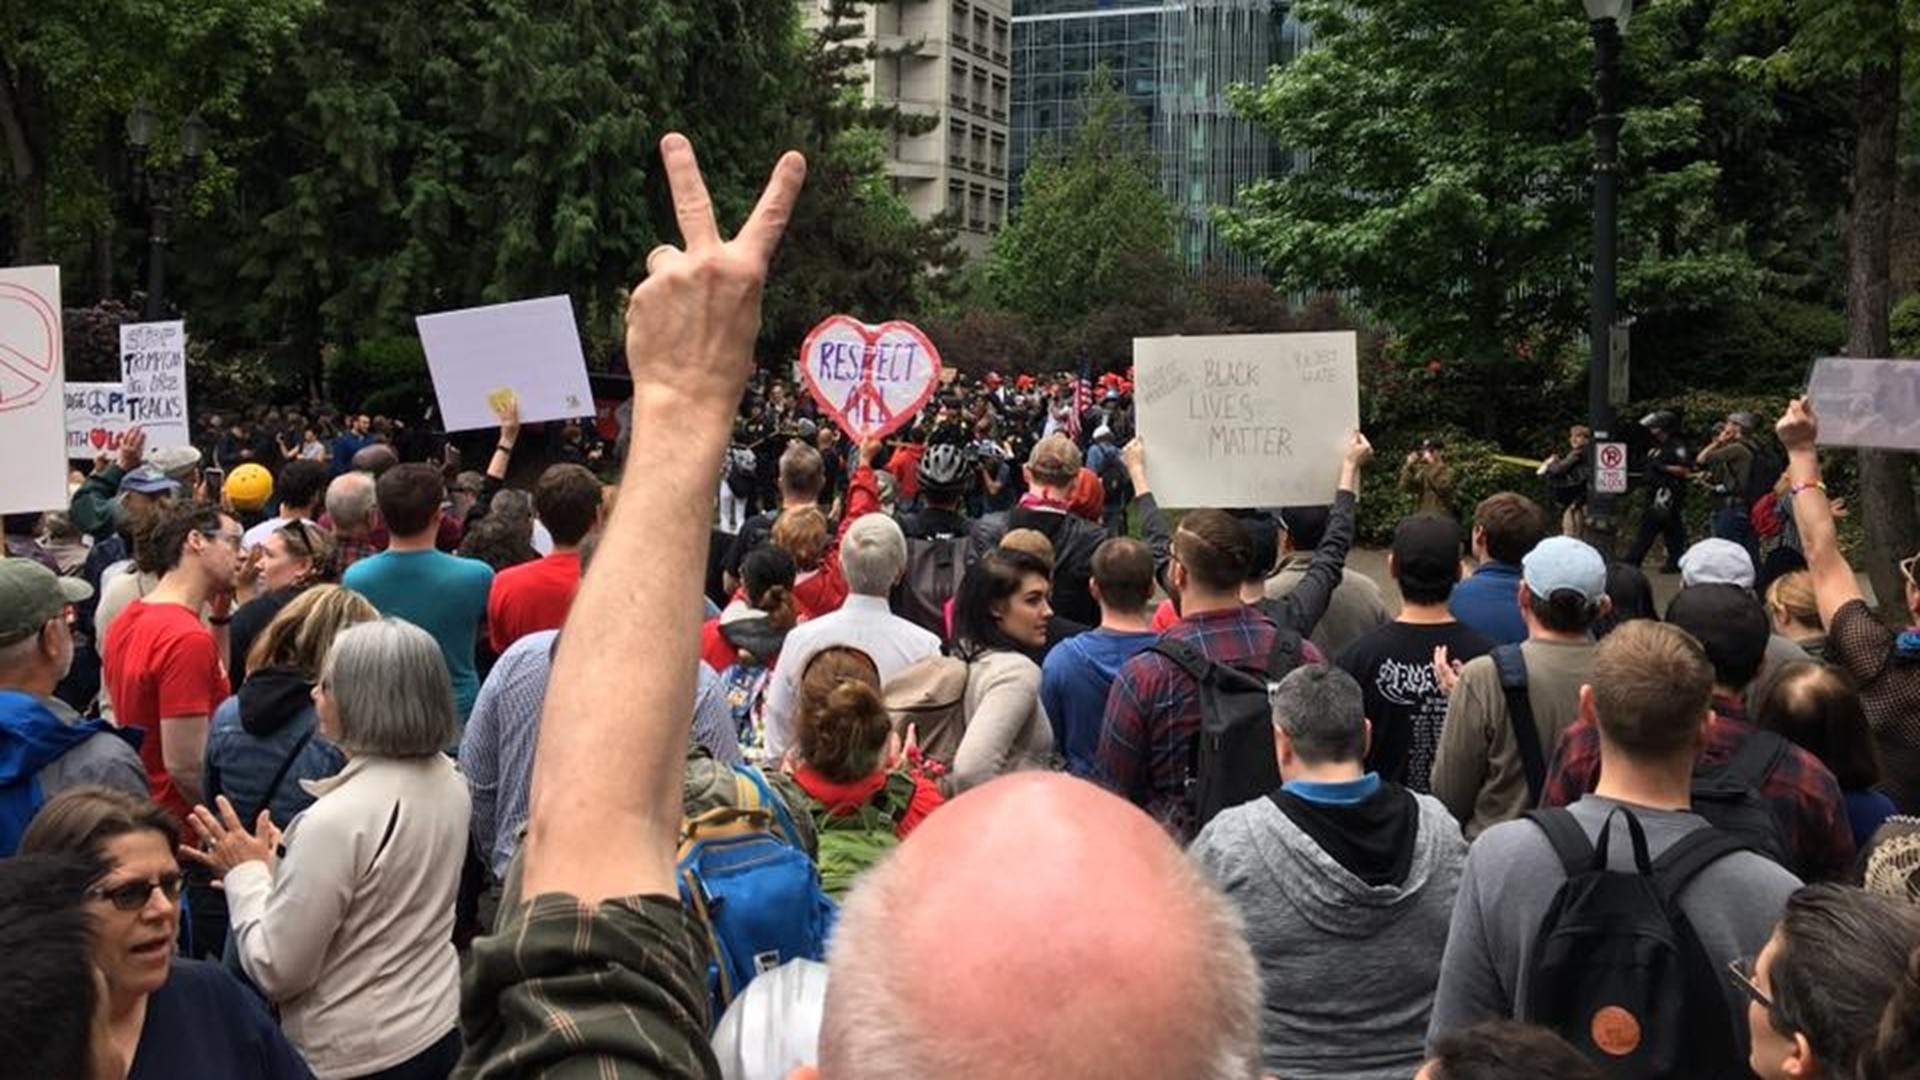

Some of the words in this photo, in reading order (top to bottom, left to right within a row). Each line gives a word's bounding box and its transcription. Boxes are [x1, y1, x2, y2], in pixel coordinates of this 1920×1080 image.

[819, 341, 918, 381] RESPECT
[1204, 358, 1260, 387] BLACK
[127, 396, 182, 421] TRACKS
[844, 385, 887, 425] ALL
[1189, 394, 1255, 420] LIVES
[1208, 426, 1293, 460] MATTER
